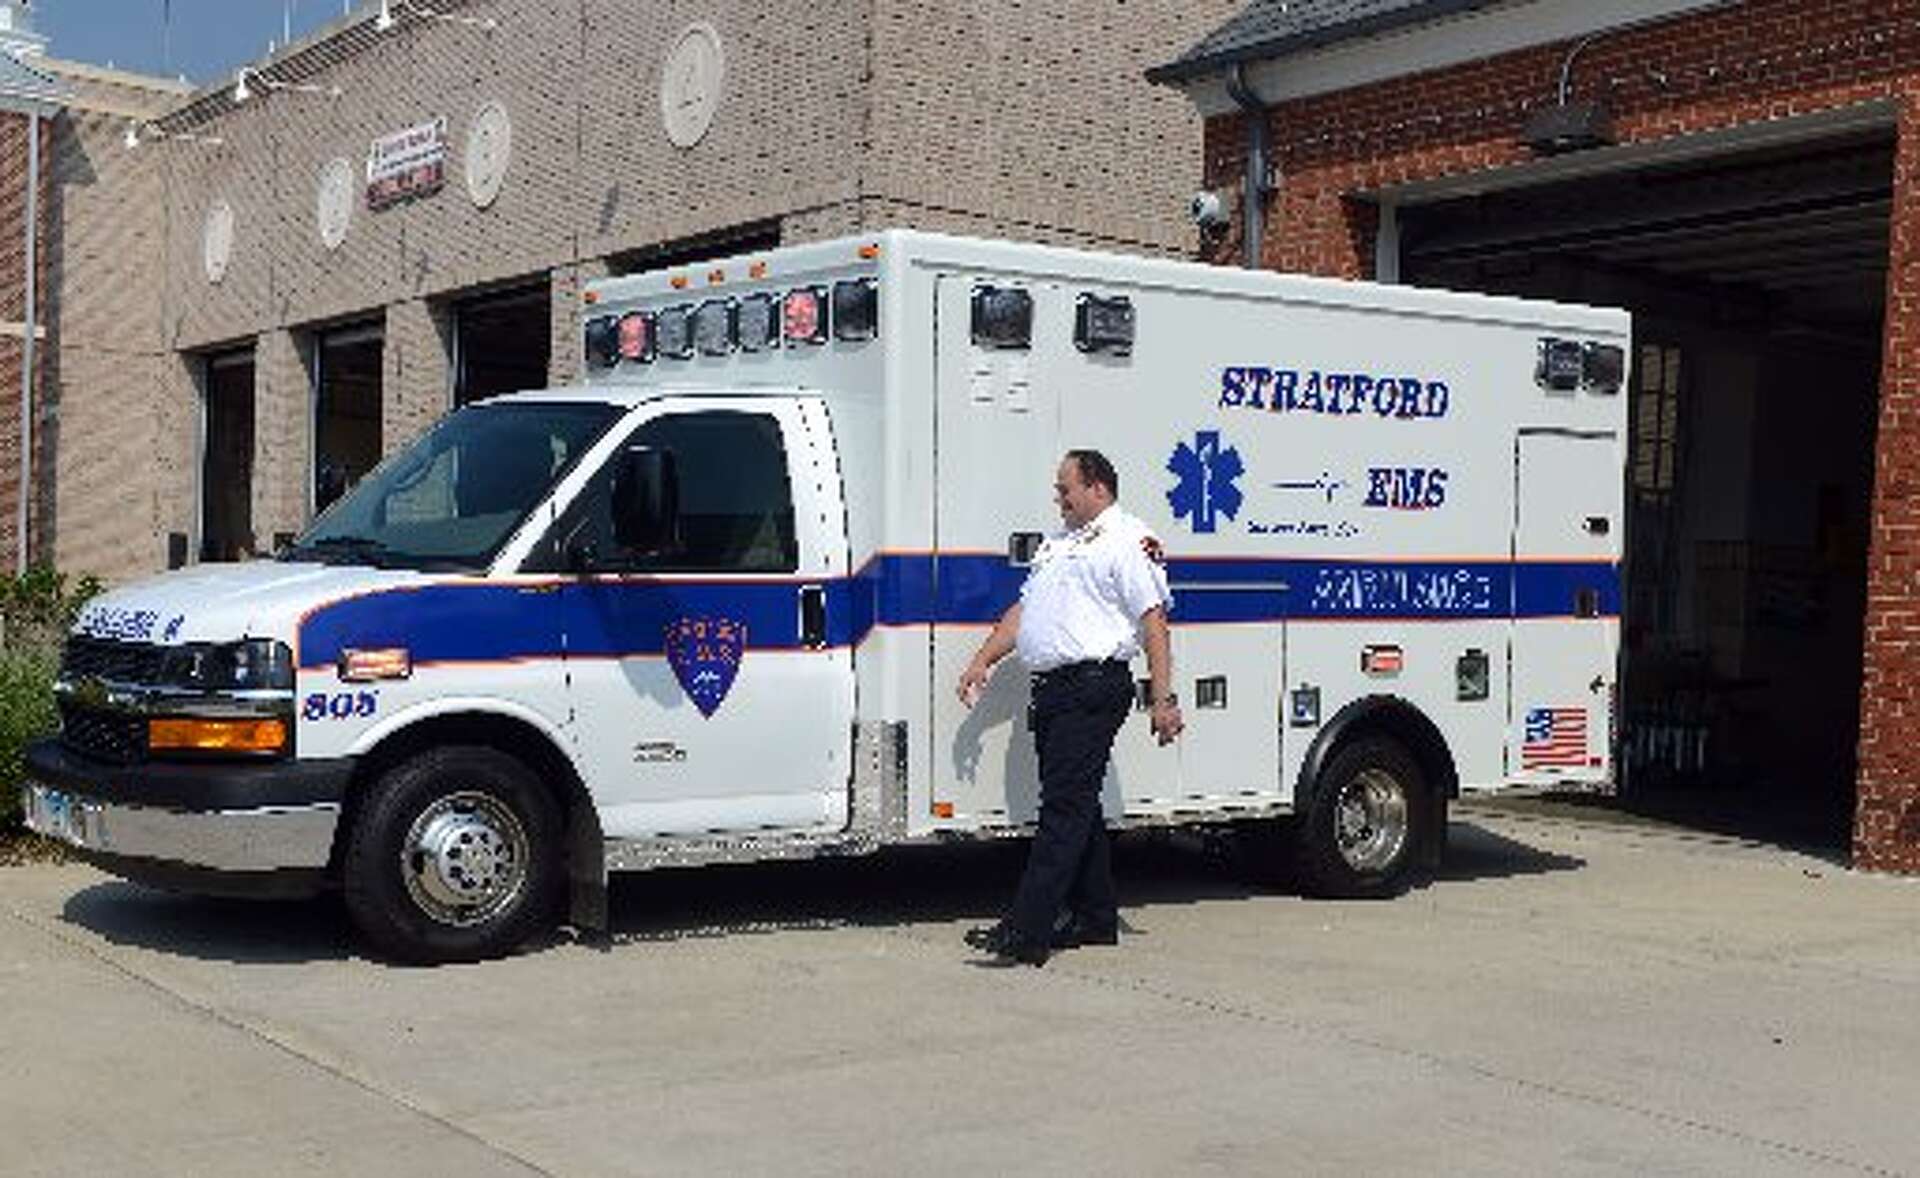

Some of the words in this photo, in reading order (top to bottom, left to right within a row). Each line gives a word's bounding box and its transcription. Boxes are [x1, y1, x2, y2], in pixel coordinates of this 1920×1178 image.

[1220, 367, 1449, 419] STRATFORD
[1364, 468, 1447, 510] EMS
[302, 691, 378, 721] 805
